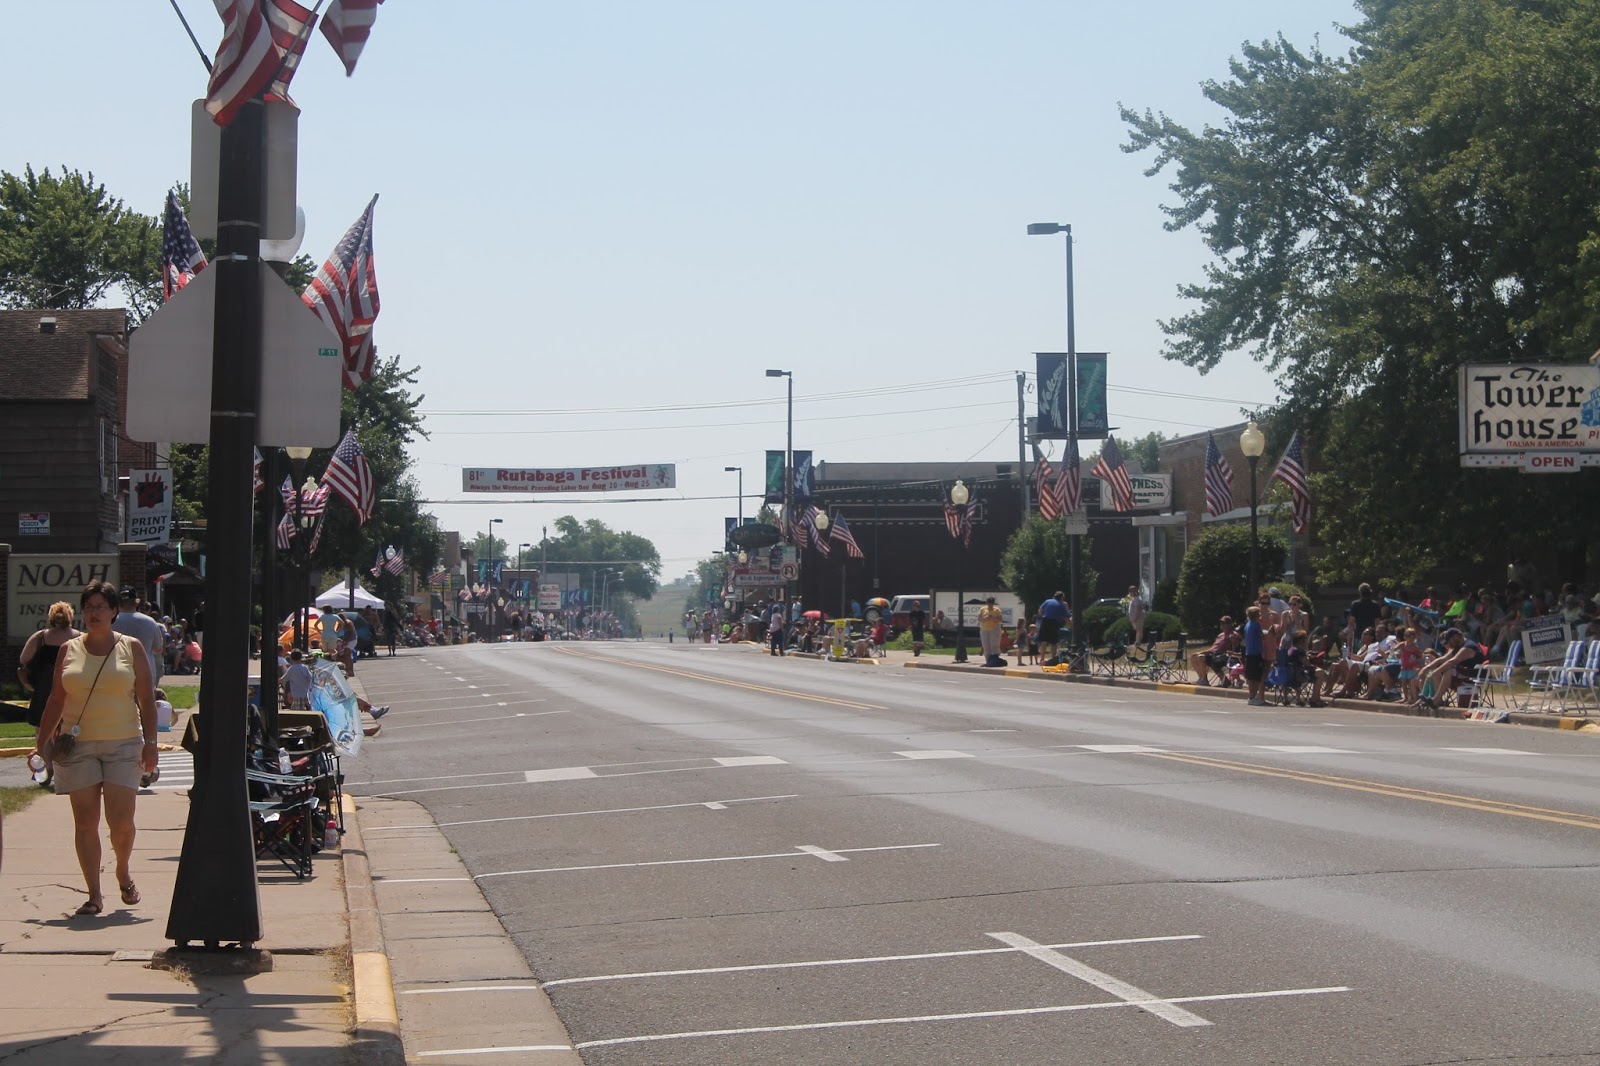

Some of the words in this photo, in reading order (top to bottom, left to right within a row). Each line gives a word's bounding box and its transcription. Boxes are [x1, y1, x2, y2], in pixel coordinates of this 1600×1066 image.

[1509, 367, 1562, 382] The
[1040, 361, 1066, 415] Welcome
[1473, 375, 1585, 408] Tower
[1474, 409, 1578, 445] house
[1506, 440, 1536, 448] ITALIAN
[1531, 457, 1575, 467] OPEN
[496, 468, 575, 483] Rutabaga
[581, 466, 647, 481] Festival
[469, 484, 491, 492] Always
[531, 484, 560, 492] Preceding
[591, 482, 607, 491] Aug
[624, 481, 639, 489] Aug
[131, 515, 168, 527] PRINT
[131, 525, 166, 537] SHOP
[16, 563, 112, 587] NOAH
